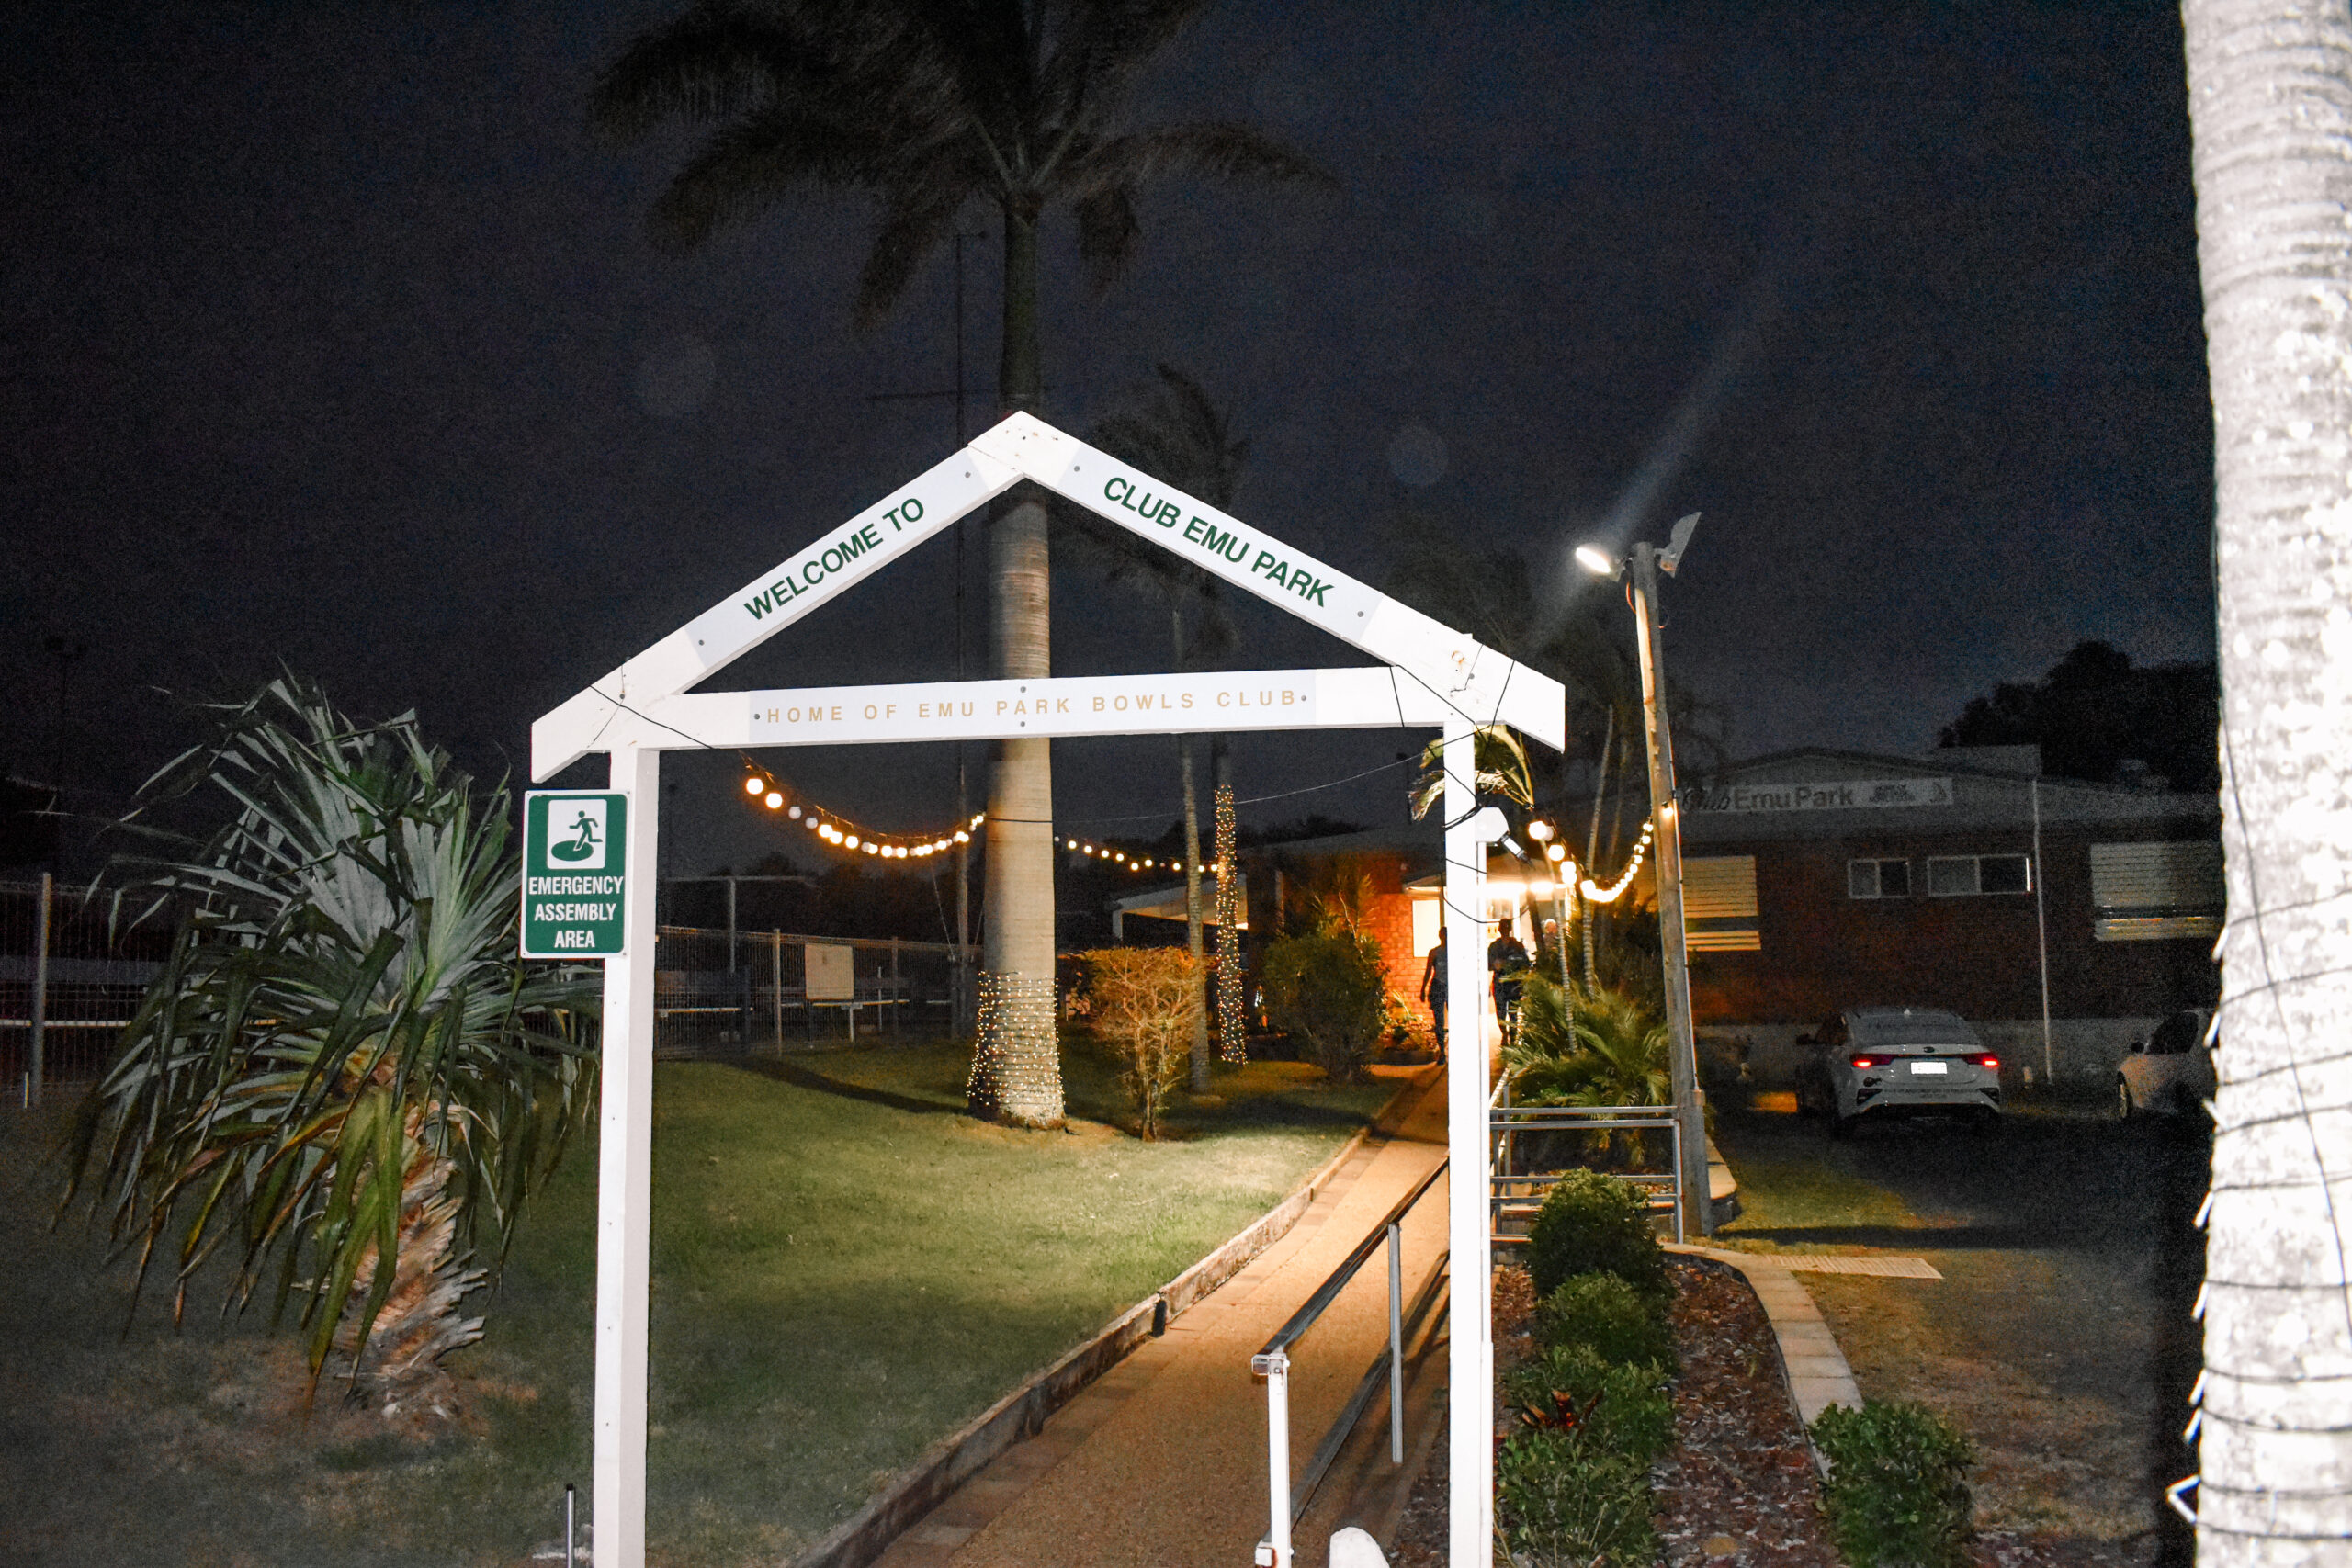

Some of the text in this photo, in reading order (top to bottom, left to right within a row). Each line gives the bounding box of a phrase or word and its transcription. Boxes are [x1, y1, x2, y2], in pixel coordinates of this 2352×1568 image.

[1103, 477, 1335, 608] CLUB EMU PARK
[743, 497, 925, 621] WELCOME TO
[767, 690, 1295, 724] HOME OF EMU PARK BOWLS CLUB
[1734, 786, 1791, 810] Emu
[1794, 784, 1853, 808] Park
[528, 875, 624, 895] EMERGENCY
[534, 903, 616, 922] ASSEMBLY
[554, 930, 596, 948] AREA
